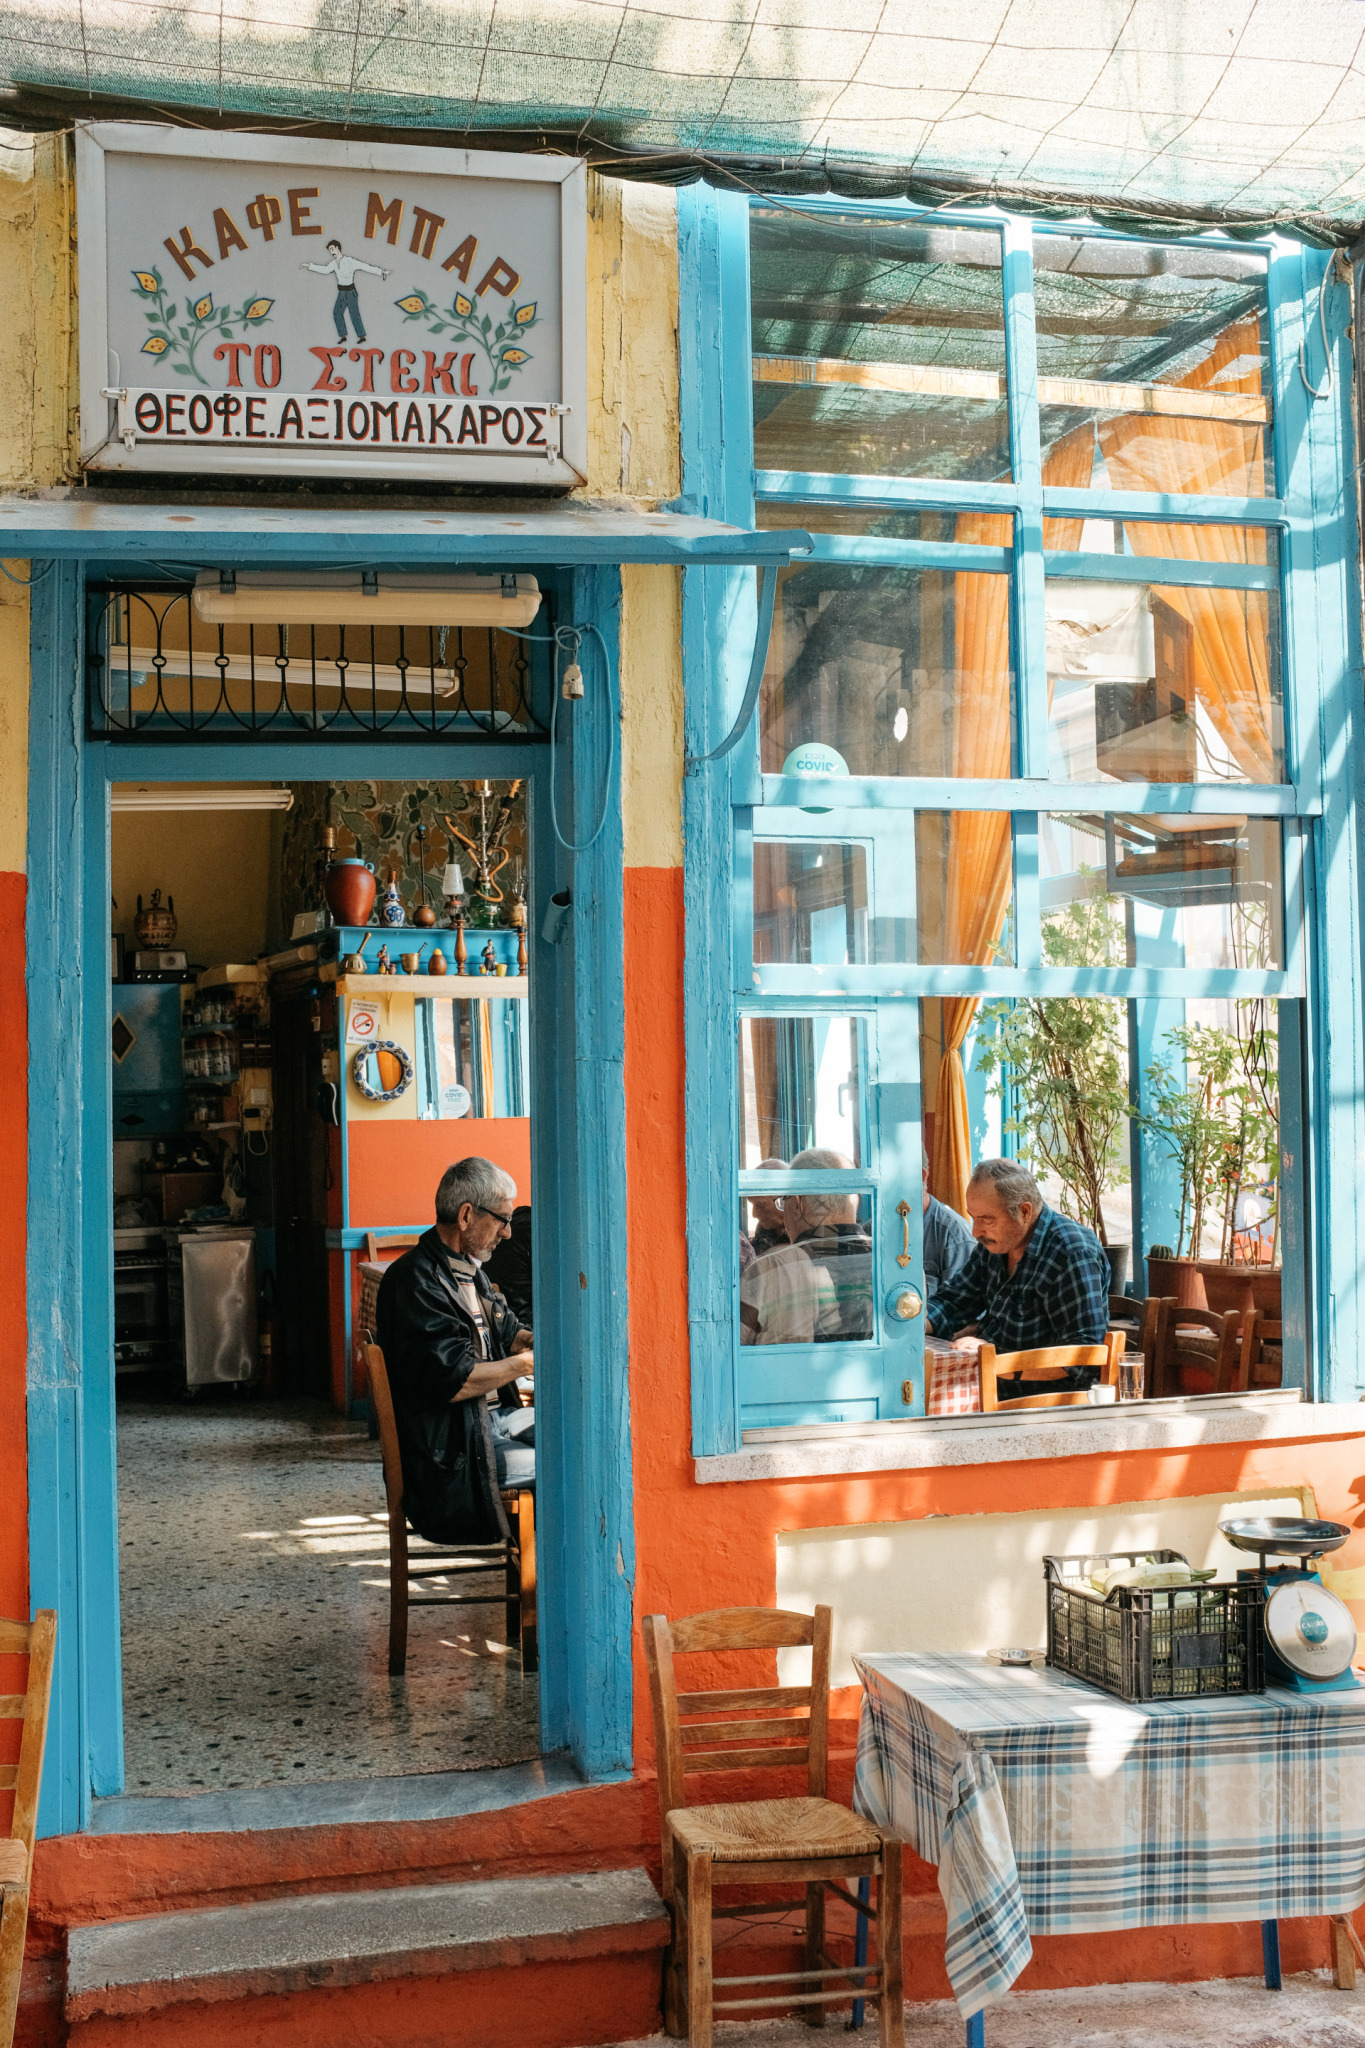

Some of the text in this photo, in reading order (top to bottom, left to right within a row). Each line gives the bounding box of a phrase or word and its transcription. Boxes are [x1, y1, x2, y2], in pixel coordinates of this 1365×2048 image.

[163, 187, 523, 298] ΚΑΦΕ ΜΠΑΡ
[213, 342, 479, 397] ΤΟ ΣΤΕΚΙ
[796, 760, 834, 771] COVID
